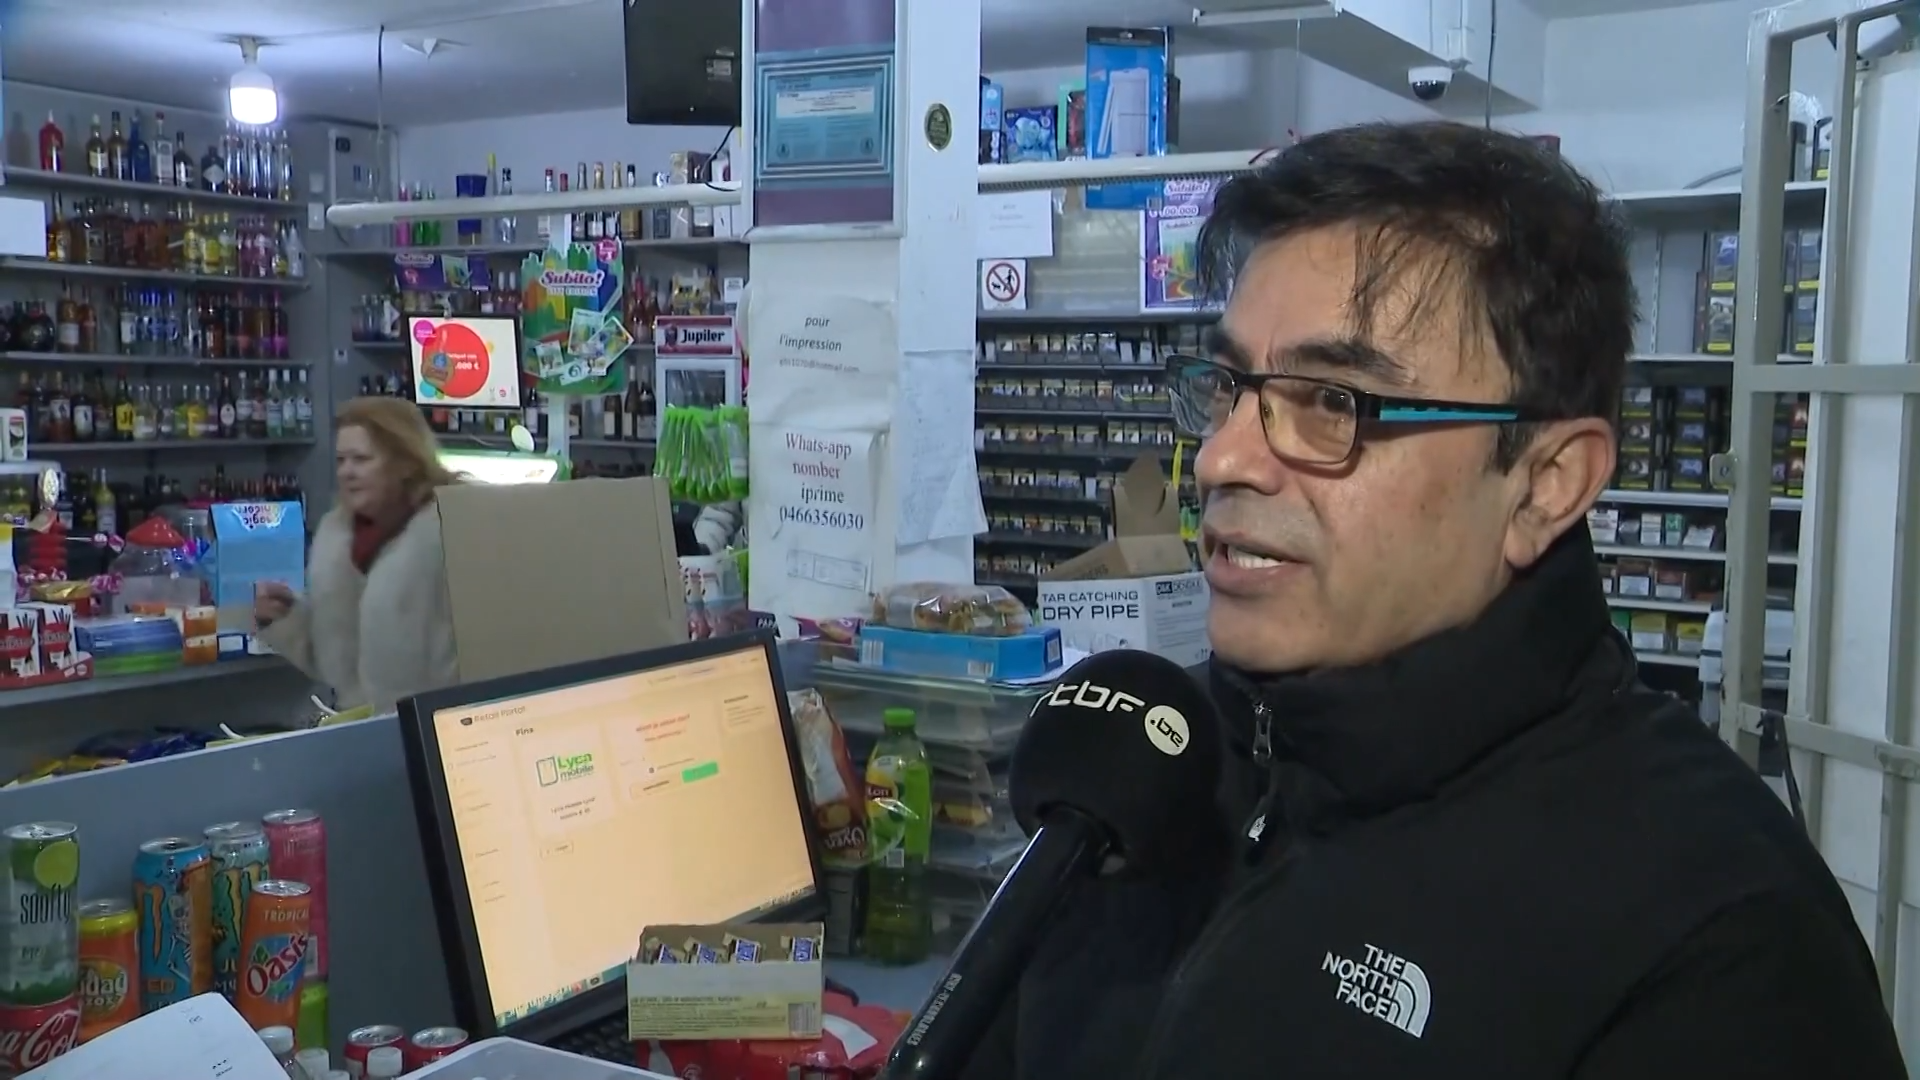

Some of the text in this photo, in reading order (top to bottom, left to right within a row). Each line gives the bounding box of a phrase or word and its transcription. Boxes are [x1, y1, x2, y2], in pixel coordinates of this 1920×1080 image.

[541, 270, 603, 285] Subito!
[804, 316, 831, 328] pour
[681, 329, 725, 344] Jupiler
[779, 333, 842, 352] l'impression
[785, 432, 853, 460] Whats-app
[792, 461, 841, 479] nomber
[801, 482, 845, 504] iprime
[779, 505, 864, 530] 0466356030
[1042, 590, 1139, 603] TAR CATCHING
[1043, 604, 1140, 621] DRY PIPE
[247, 933, 308, 997] Oasis
[1364, 943, 1406, 977] THE
[1321, 951, 1398, 999] NORTH
[1336, 980, 1391, 1020] FACE
